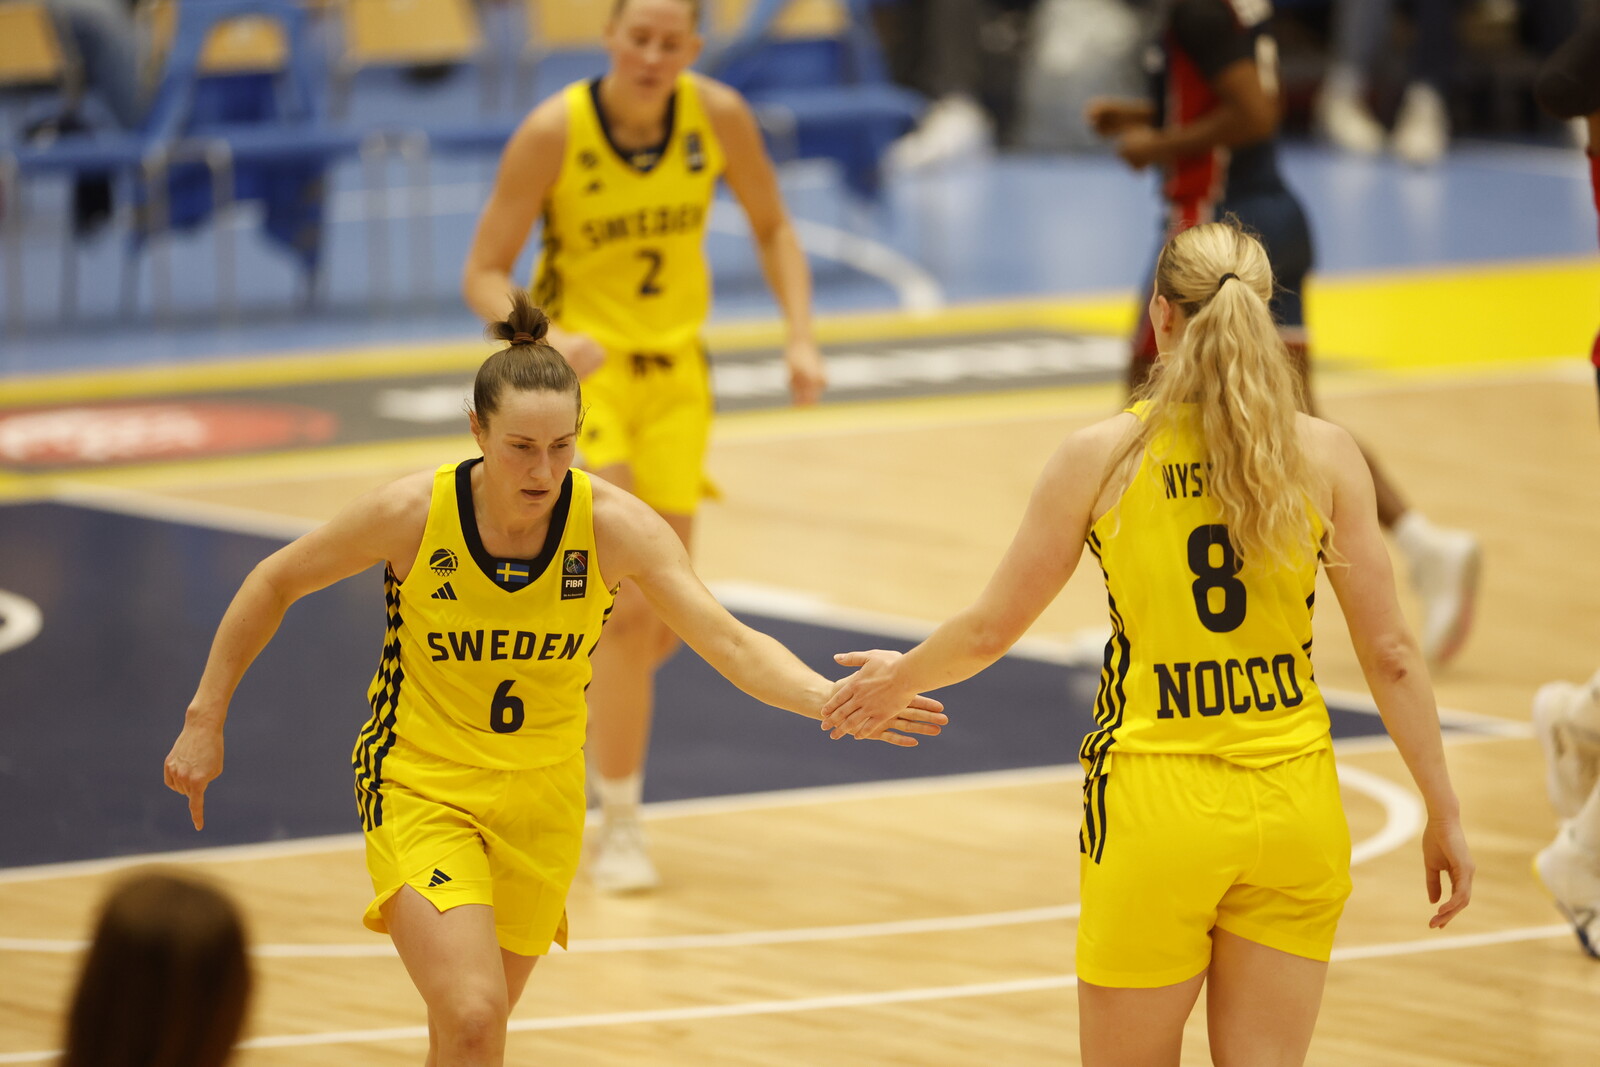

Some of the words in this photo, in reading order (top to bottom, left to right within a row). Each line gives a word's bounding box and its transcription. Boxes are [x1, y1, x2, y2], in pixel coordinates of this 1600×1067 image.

[581, 203, 703, 248] SWEDEN
[634, 249, 663, 297] 2
[1162, 462, 1213, 499] NYS
[565, 579, 583, 588] FIBA
[1187, 524, 1247, 633] 8
[427, 629, 584, 662] SWEDEN
[490, 679, 525, 733] 6
[1153, 653, 1303, 719] NOCCO
